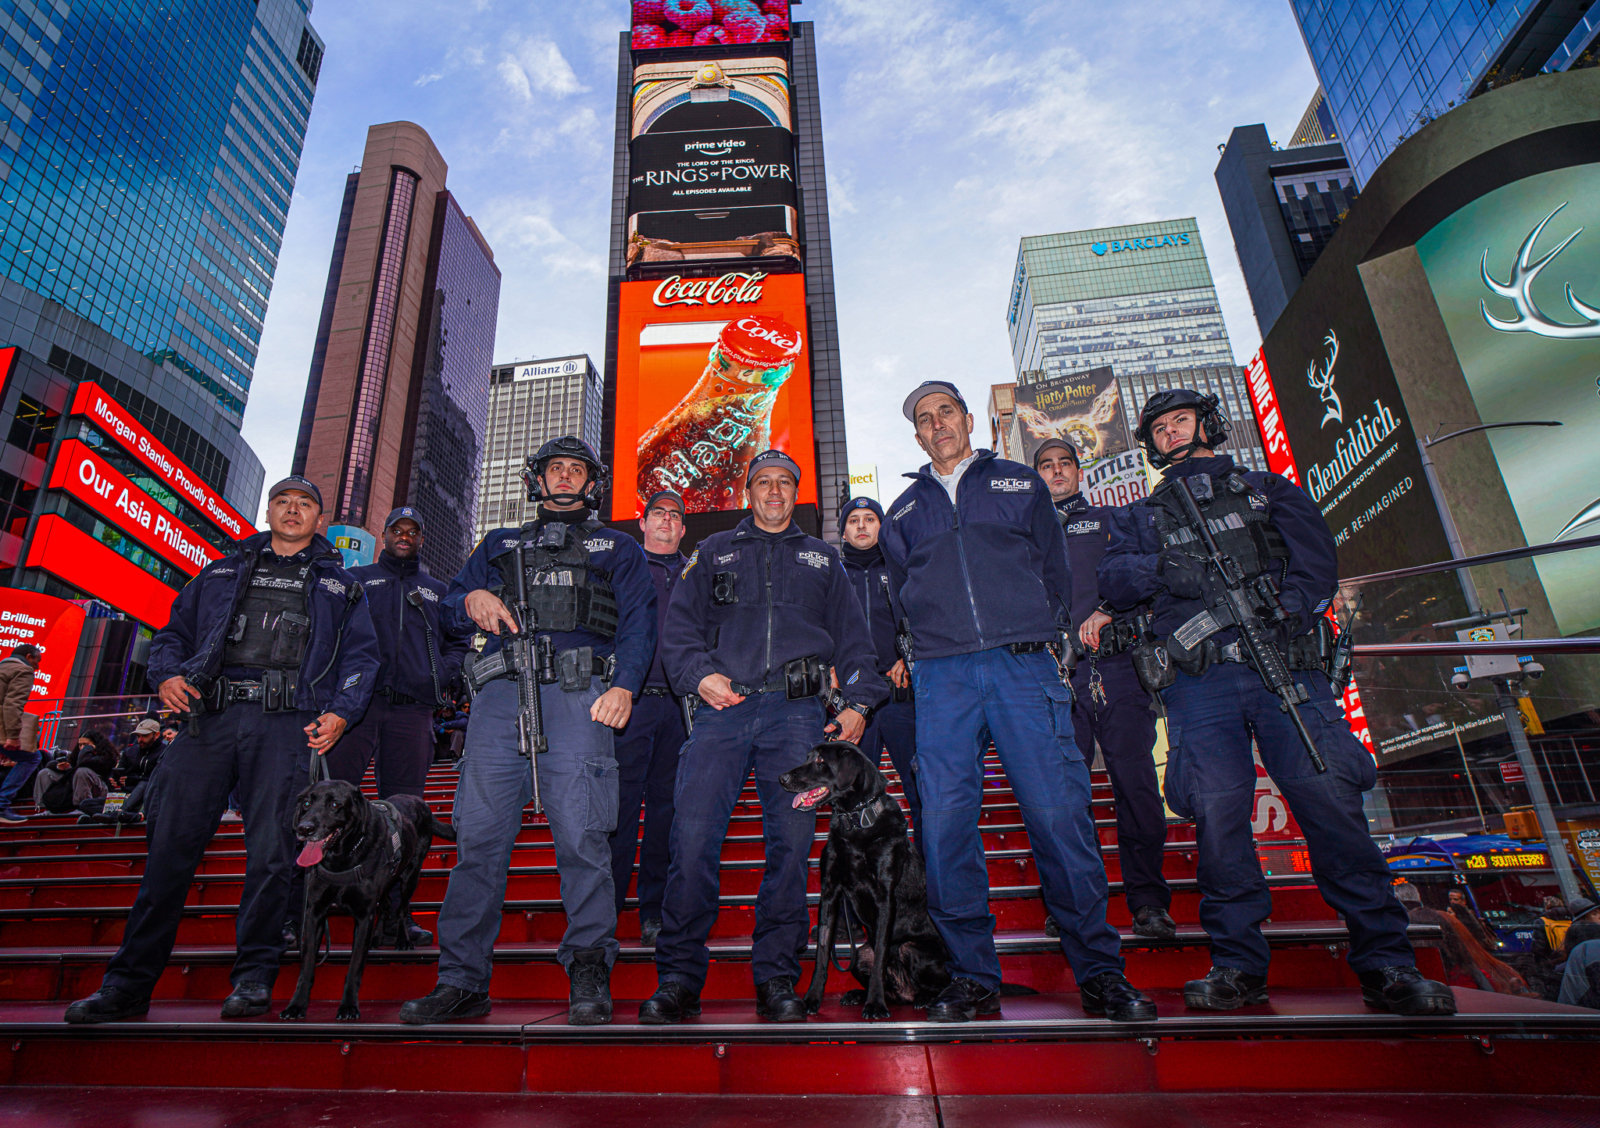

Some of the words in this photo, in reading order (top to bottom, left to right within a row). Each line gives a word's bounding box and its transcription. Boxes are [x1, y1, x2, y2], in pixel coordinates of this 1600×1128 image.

[684, 141, 715, 152] prime
[717, 139, 746, 149] video
[632, 175, 644, 184] THE
[645, 168, 709, 187] RINGS
[721, 164, 792, 183] POWER
[1111, 232, 1190, 253] BARCLAYS
[737, 318, 794, 350] Coke
[522, 364, 561, 378] Allianz
[1050, 373, 1090, 387] BROADWAY
[1036, 390, 1065, 410] Harry
[1064, 383, 1096, 401] Potter
[1307, 399, 1397, 503] Glenfiddich
[94, 397, 137, 445] Morgan
[138, 437, 174, 477] Stanley
[175, 469, 207, 507] Proudly
[207, 497, 241, 535] Supports
[1087, 454, 1135, 489] LITTLE
[1338, 485, 1352, 503] MALT
[1352, 464, 1376, 489] SCOTCH
[1375, 442, 1399, 468] WHISKY
[849, 473, 874, 485] irect
[991, 480, 1031, 488] POLICE
[79, 459, 114, 499] Our
[115, 488, 152, 529] Asia
[1068, 521, 1100, 531] POLICE
[799, 552, 829, 563] POLICE
[1, 610, 46, 628] Brilliant
[1490, 854, 1518, 867] SOUTH
[1517, 853, 1545, 866] FERRY
